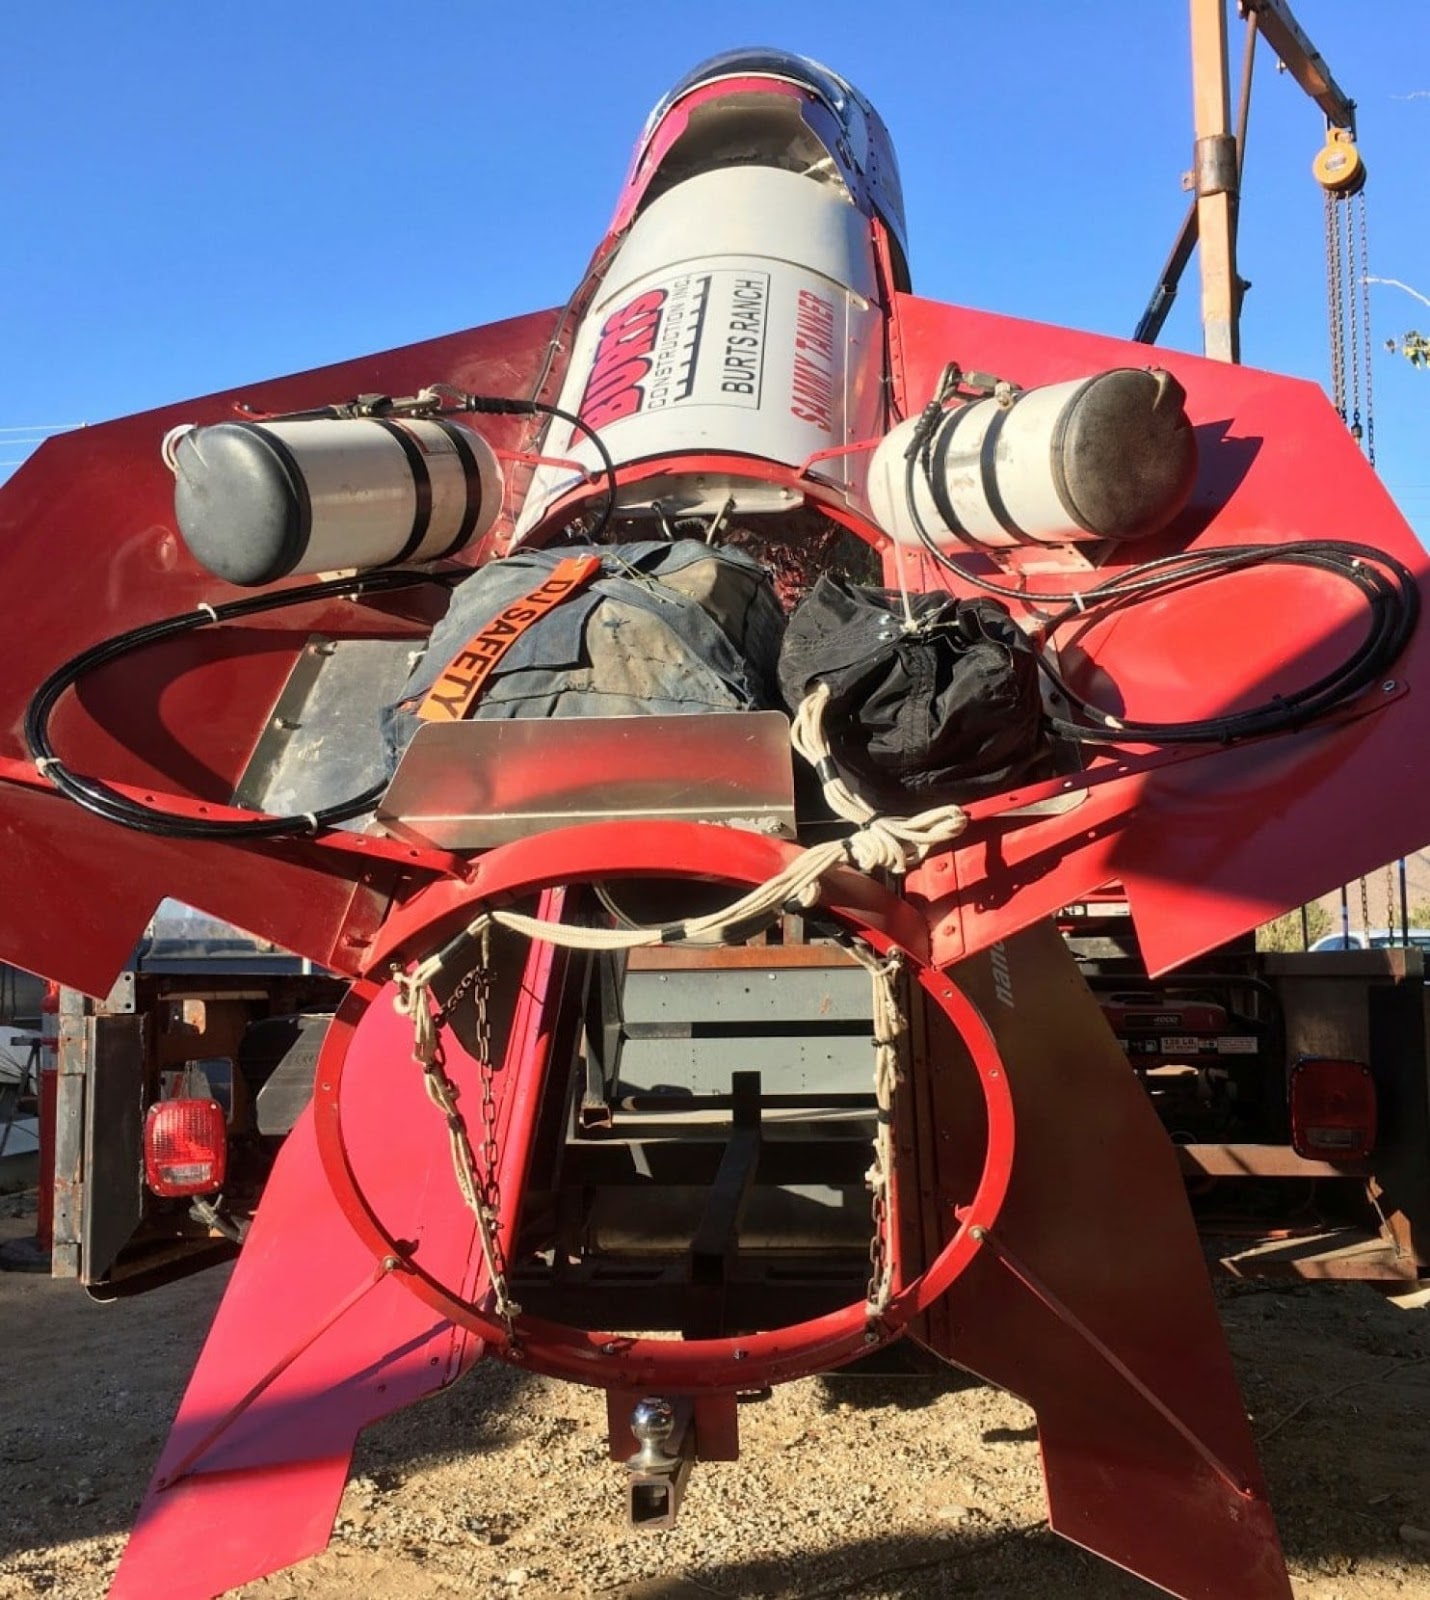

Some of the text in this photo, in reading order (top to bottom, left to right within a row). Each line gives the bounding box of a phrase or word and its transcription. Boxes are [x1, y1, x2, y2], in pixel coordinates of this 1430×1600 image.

[566, 288, 669, 452] BURTS
[647, 302, 685, 409] CONSTRUCTION
[721, 279, 764, 395] BURTS RANCH
[791, 289, 834, 432] SAMMY TANNER
[431, 579, 575, 718] DJ SAFETY
